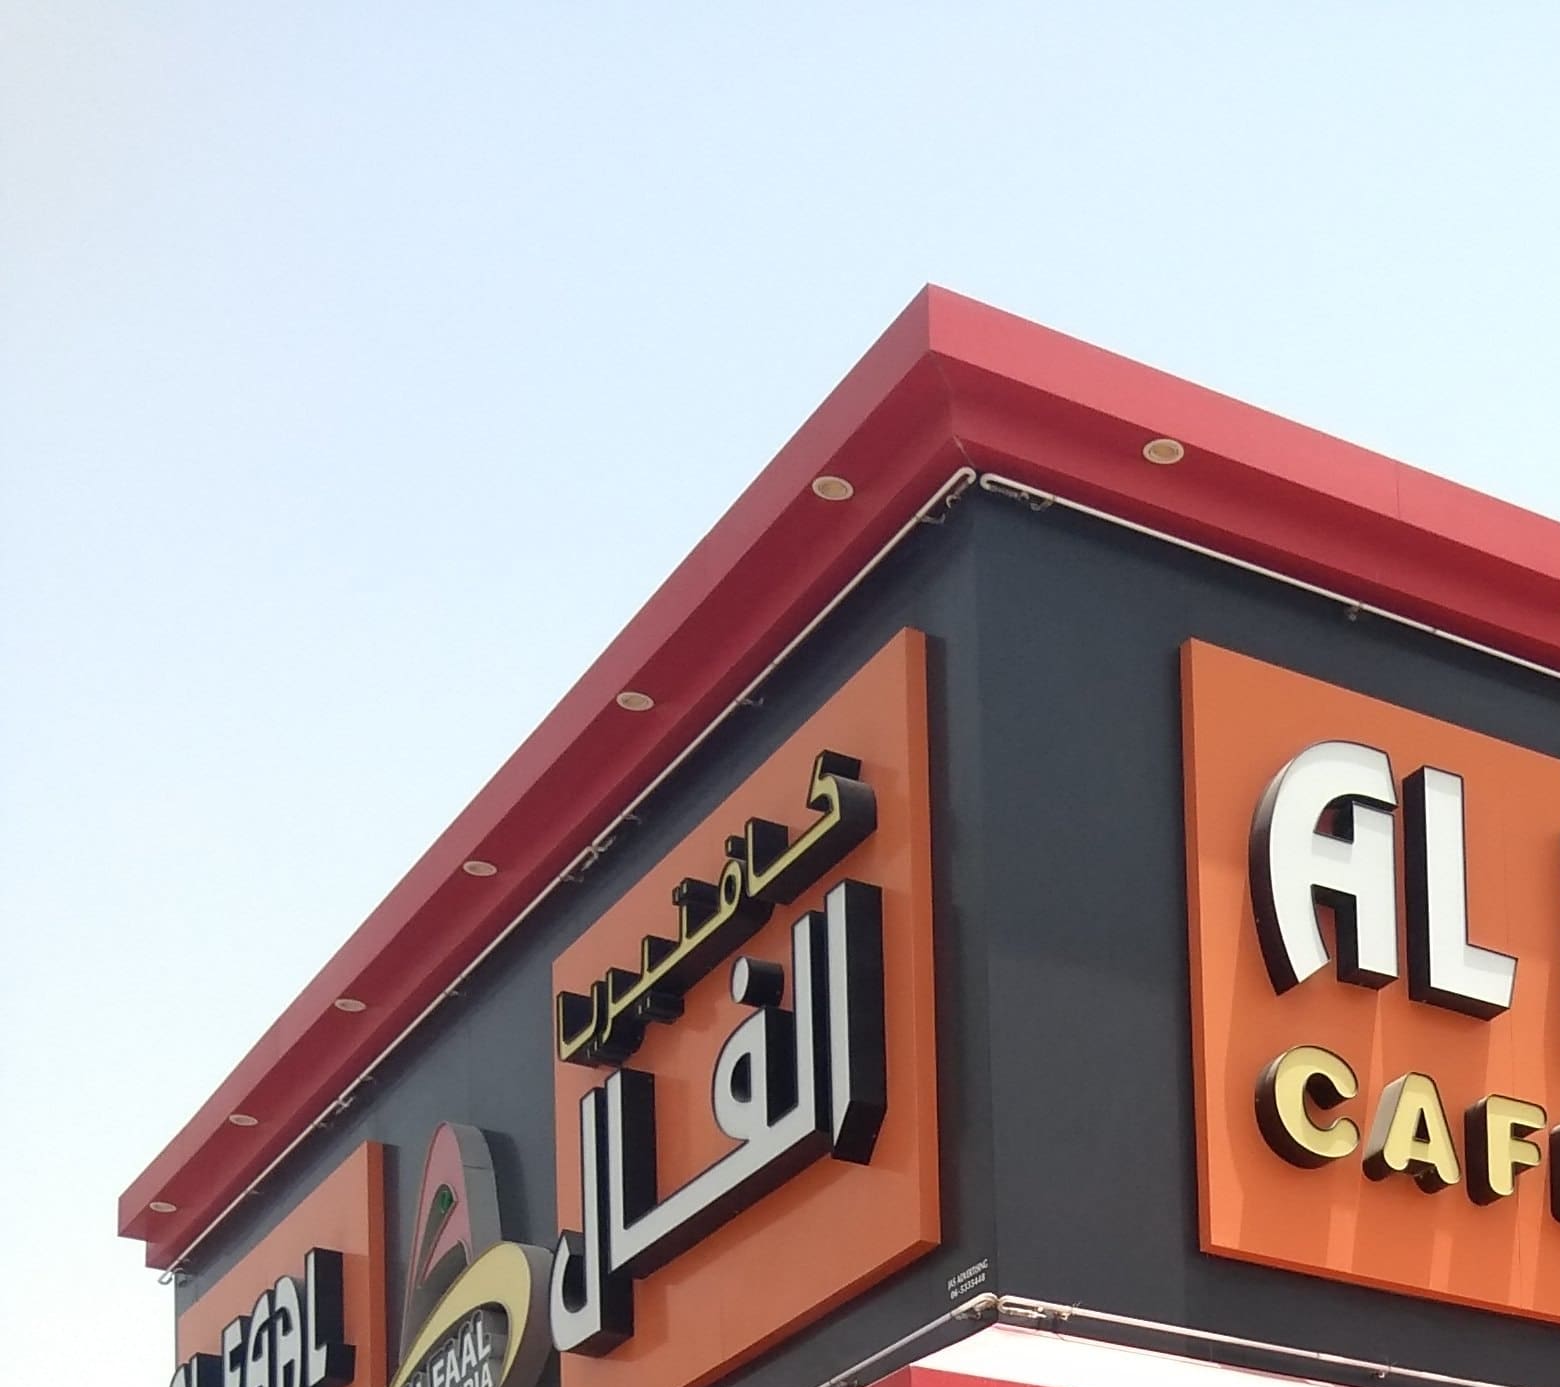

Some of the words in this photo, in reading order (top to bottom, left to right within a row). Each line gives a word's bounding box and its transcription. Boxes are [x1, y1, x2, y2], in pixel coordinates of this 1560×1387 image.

[557, 750, 850, 1062] كافتيريا
[1251, 739, 1518, 1020] AL
[550, 879, 865, 1354] الفال
